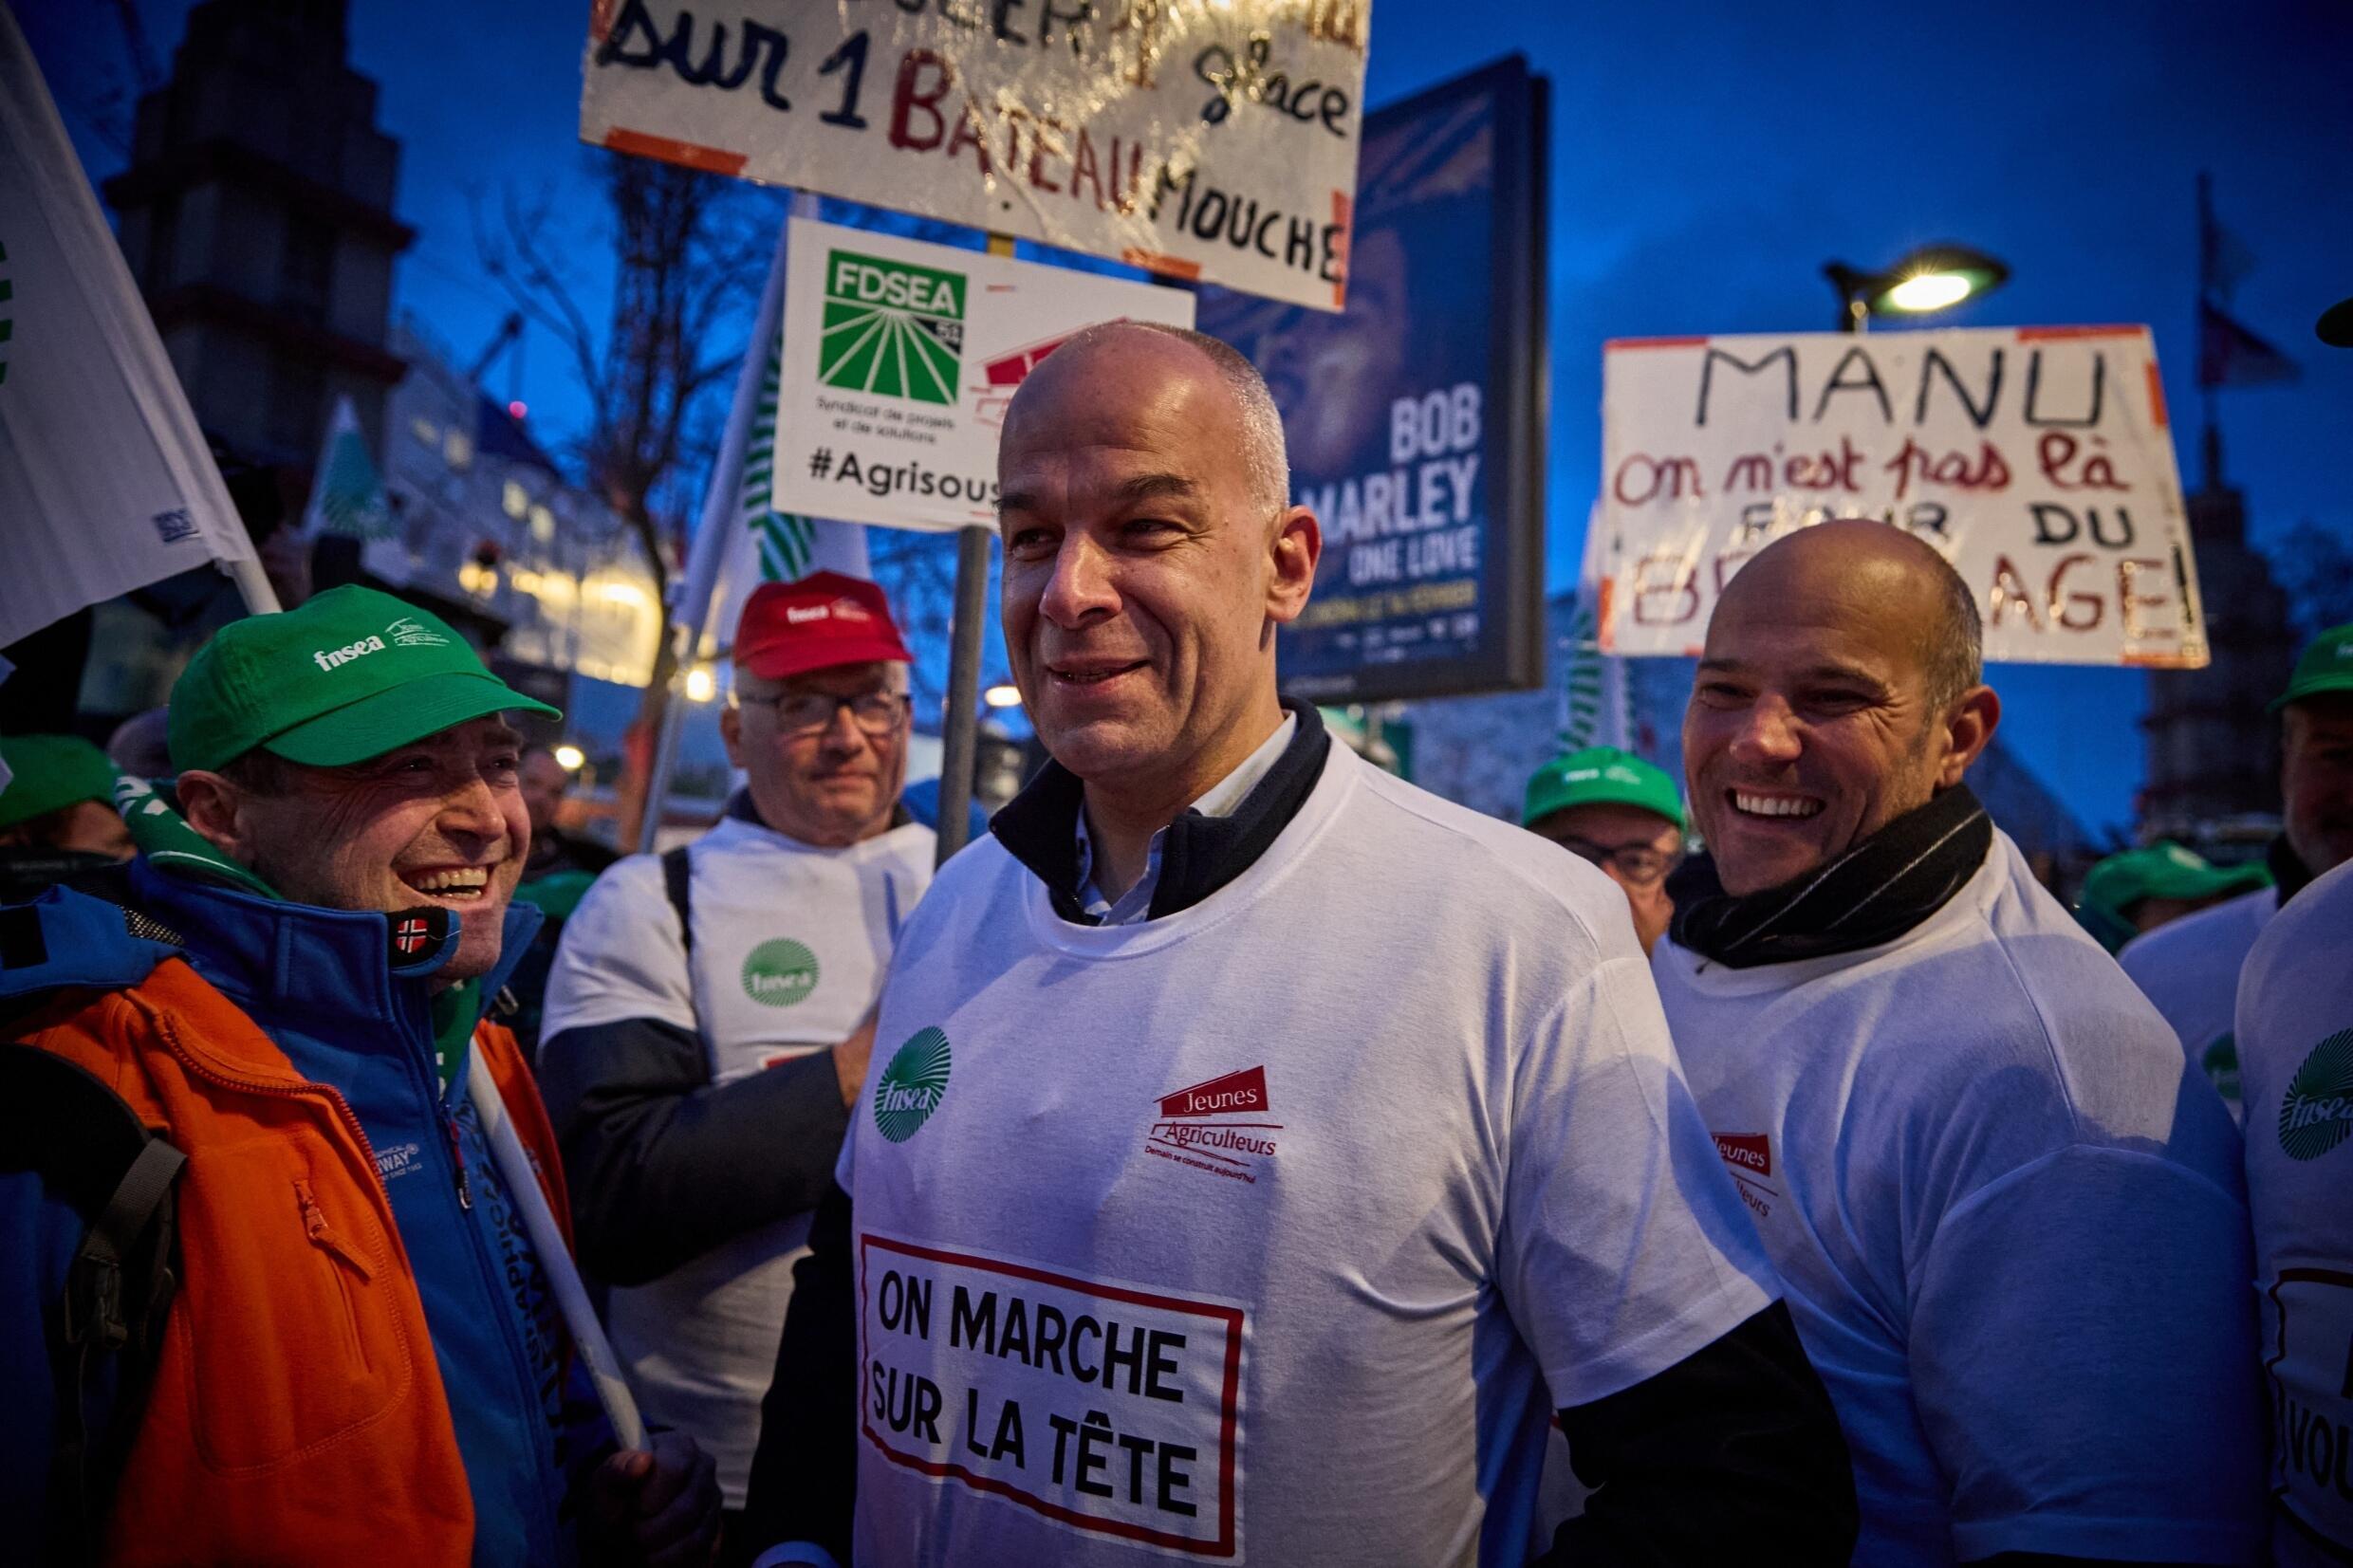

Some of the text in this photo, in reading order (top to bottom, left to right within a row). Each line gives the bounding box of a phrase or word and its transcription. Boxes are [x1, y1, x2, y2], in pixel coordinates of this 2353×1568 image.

[818, 31, 867, 130] 1
[889, 49, 1145, 216] BATEAU
[1149, 165, 1344, 283] MOUCHE
[835, 261, 957, 316] FDSEA
[1695, 346, 2105, 428] MANU
[817, 396, 954, 431] Syndicat de projets
[833, 419, 936, 444] et de solutions
[1391, 383, 1481, 463] BOB
[1884, 435, 2010, 499] pas
[2038, 431, 2132, 492] là
[2027, 503, 2135, 549] DU
[1350, 525, 1480, 586] ONE LOVE
[313, 636, 386, 672] fnsea
[881, 1079, 932, 1113] fnsea
[1184, 1089, 1257, 1113] Jeunes
[1163, 1121, 1276, 1155] Agriculteurs
[1144, 1145, 1257, 1185] Demain se construit aujourd'hui
[879, 1269, 1187, 1404] ON MARCHE
[872, 1359, 1197, 1518] SUR LA TÊTE
